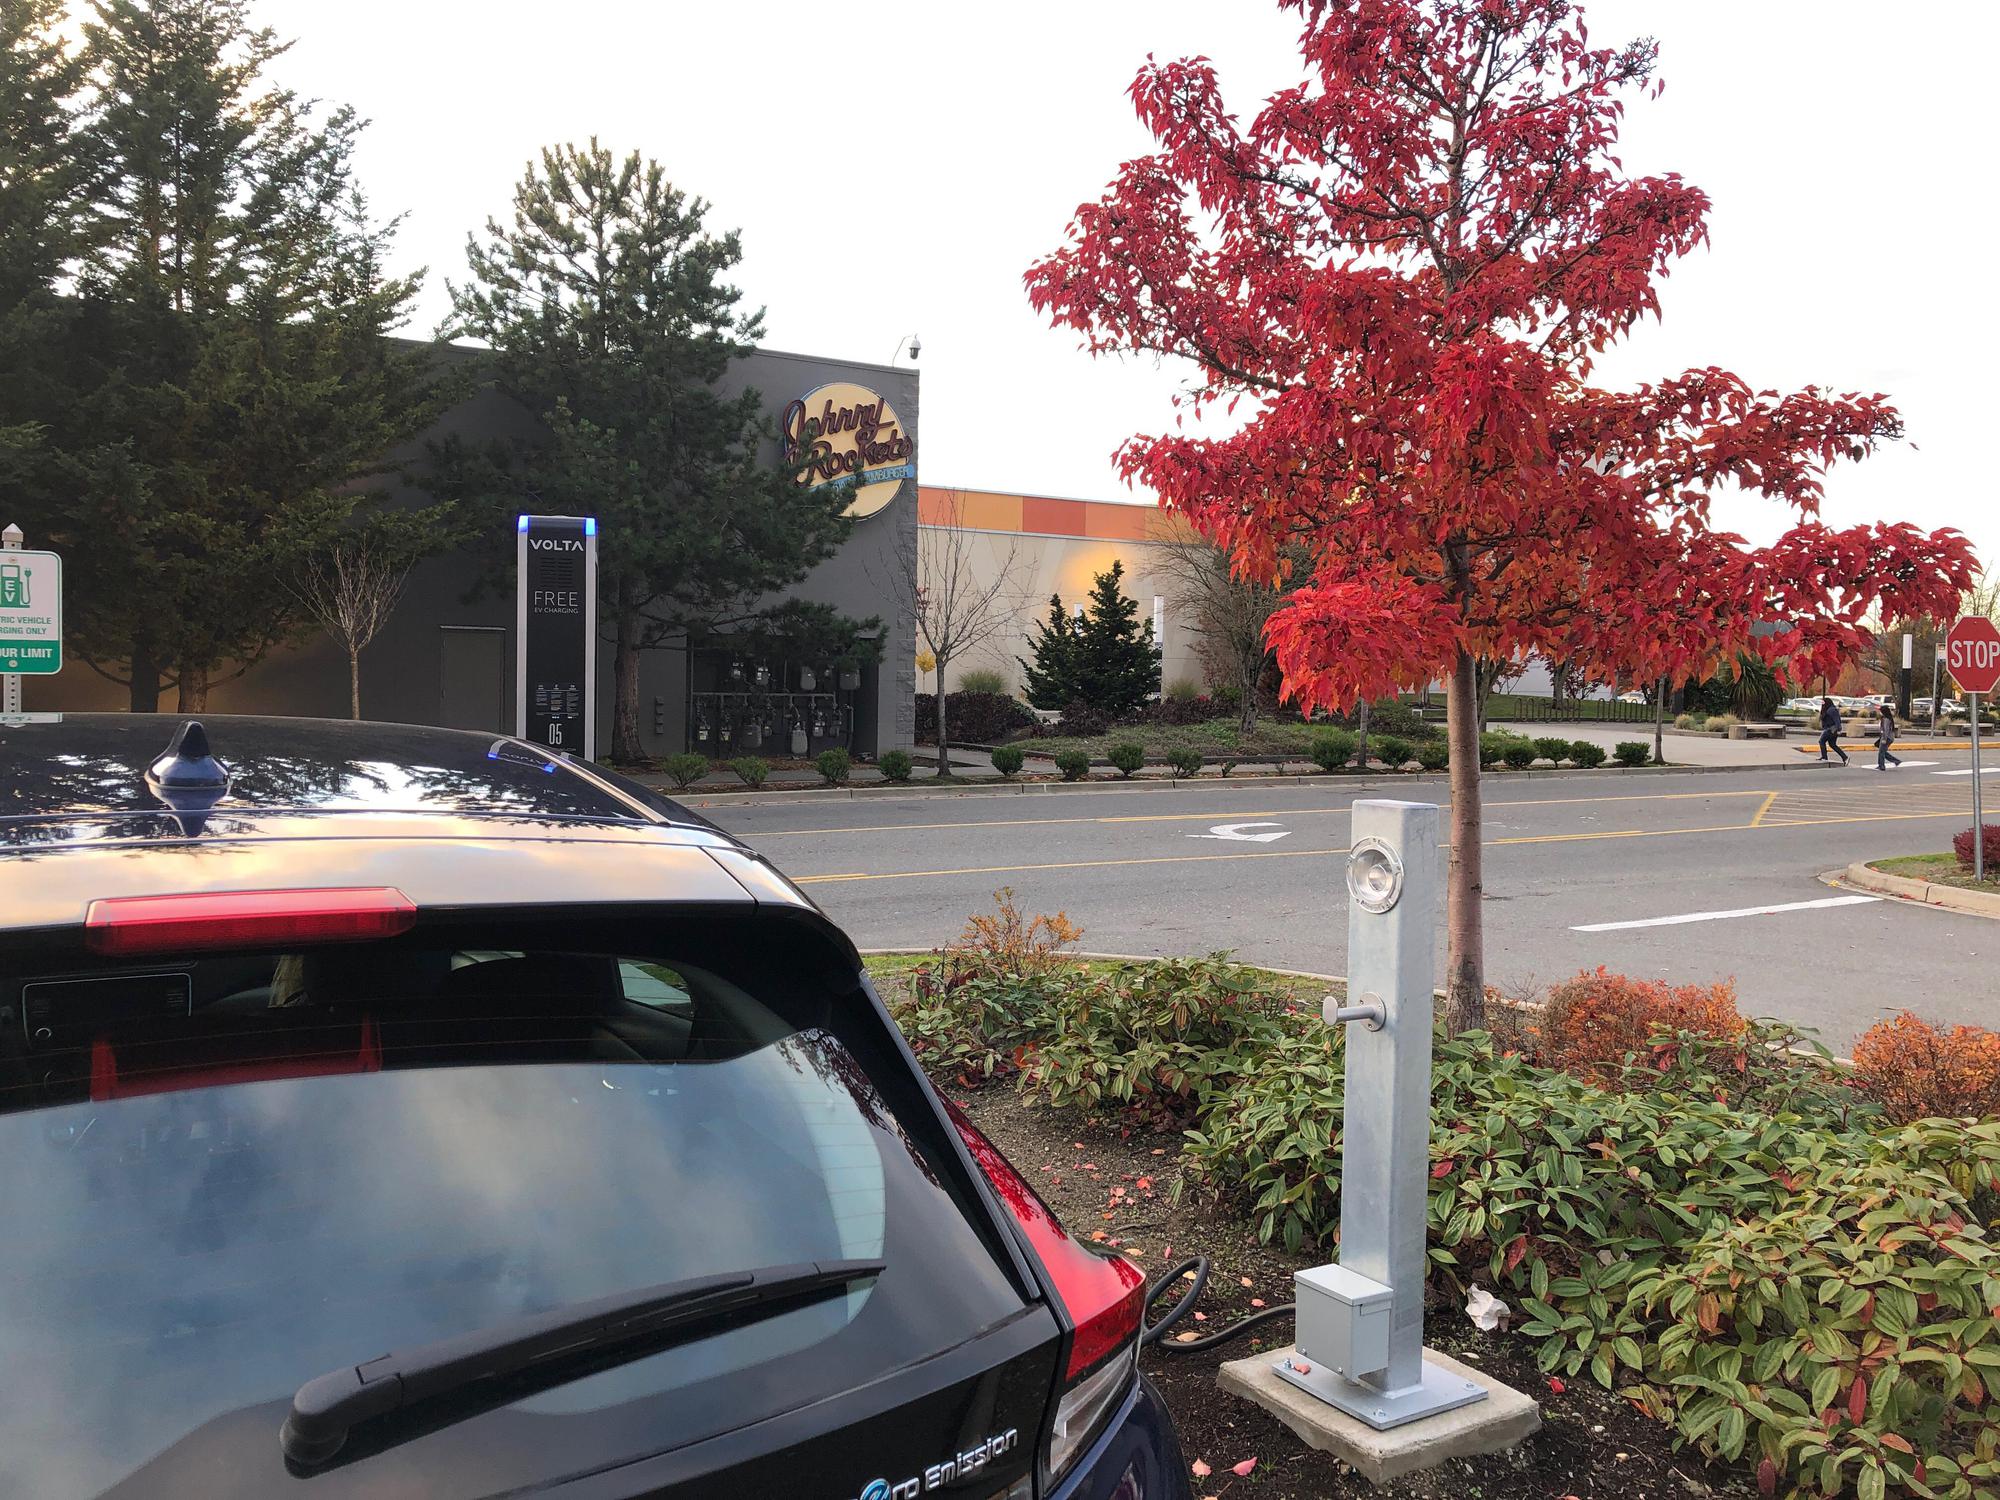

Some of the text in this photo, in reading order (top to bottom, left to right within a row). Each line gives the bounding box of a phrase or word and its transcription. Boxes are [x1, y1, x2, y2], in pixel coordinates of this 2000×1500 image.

[783, 398, 896, 464] Johnny
[795, 429, 913, 487] Rockets
[529, 539, 584, 551] VOLTA
[534, 591, 578, 606] FREE
[0, 616, 52, 624] RIC VEHICLE
[26, 627, 47, 635] ONLY
[0, 647, 53, 658] UR LIMIT
[1951, 640, 2000, 668] STOP
[548, 723, 562, 745] 05
[925, 1428, 1018, 1491] Emission
